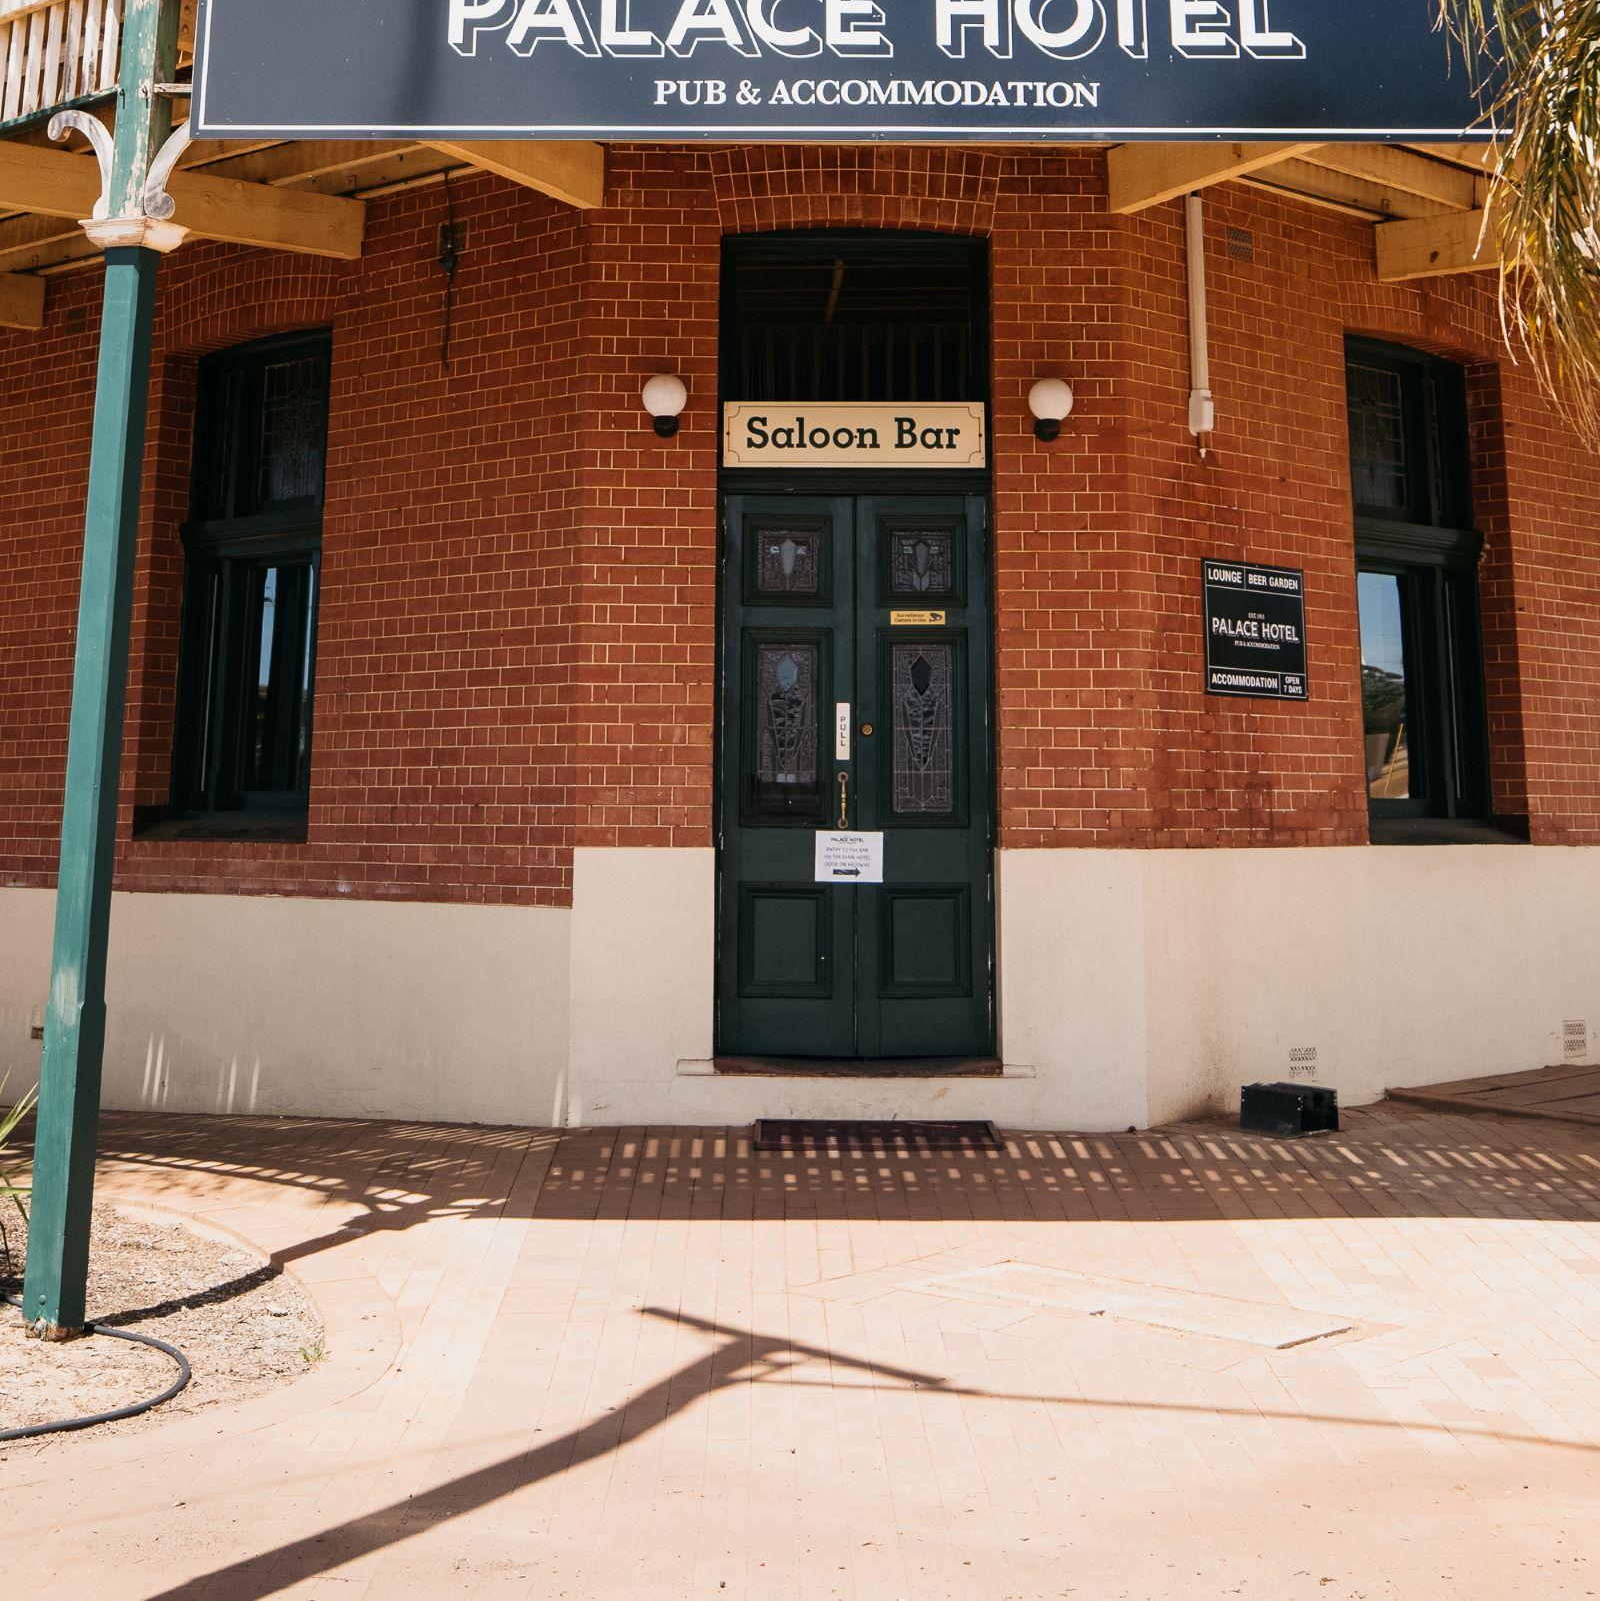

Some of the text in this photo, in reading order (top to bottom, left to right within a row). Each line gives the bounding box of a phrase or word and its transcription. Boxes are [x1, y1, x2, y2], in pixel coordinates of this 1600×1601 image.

[654, 79, 1100, 107] PUB & ACCOMMODATION
[746, 416, 961, 449] Saloon Bar
[1208, 568, 1242, 584] LOUNGE
[1248, 574, 1298, 590] BEER GARDEN
[1212, 617, 1300, 643] PALACE HOTEL
[1212, 673, 1278, 689] ACCOMMODATION
[1285, 676, 1300, 685] OPEN
[1288, 685, 1302, 694] DAYS
